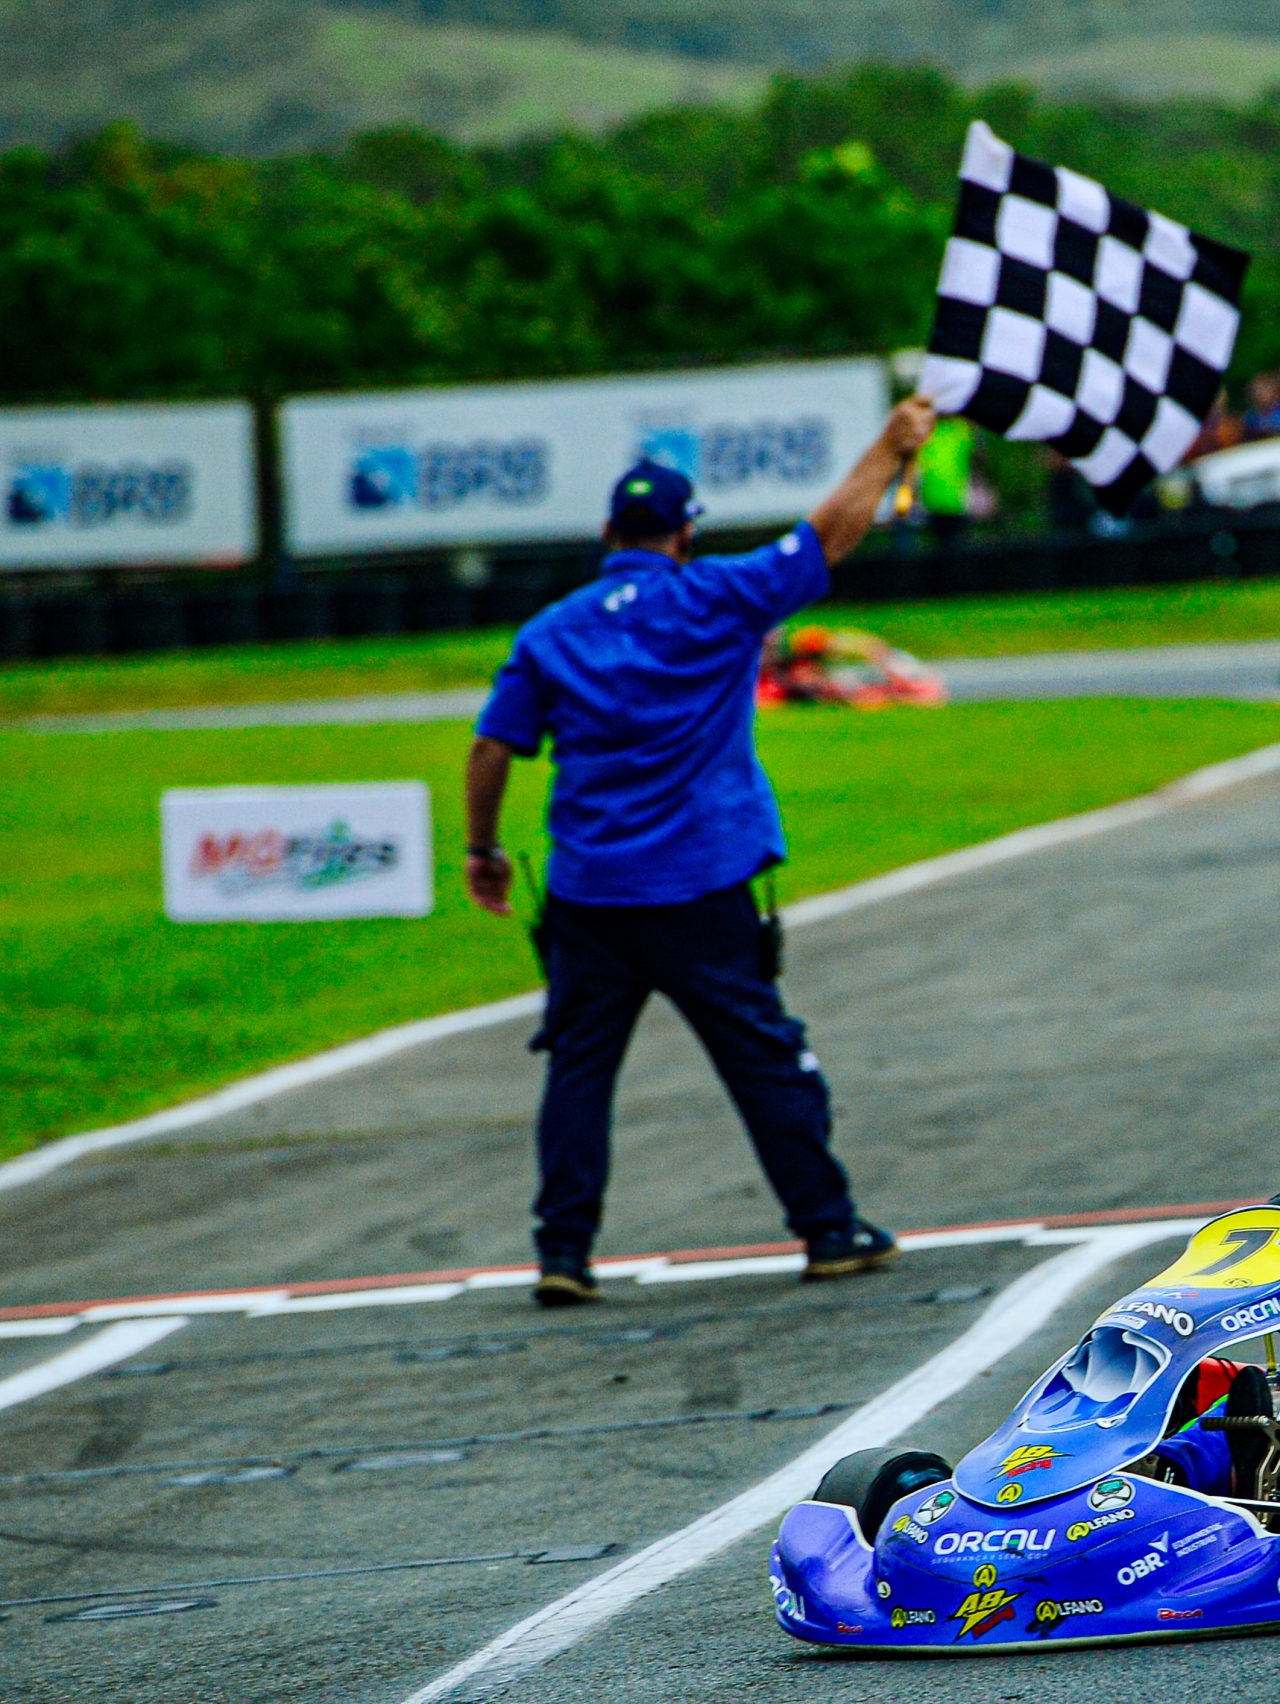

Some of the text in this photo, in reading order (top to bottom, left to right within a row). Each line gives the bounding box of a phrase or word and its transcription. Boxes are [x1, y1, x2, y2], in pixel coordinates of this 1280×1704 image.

[1184, 1227, 1280, 1277] 7
[1066, 1508, 1136, 1541] ALFANO
[934, 1529, 1056, 1555] ORCALI
[1117, 1552, 1165, 1586] OBR
[1036, 1599, 1103, 1622] ALFANO
